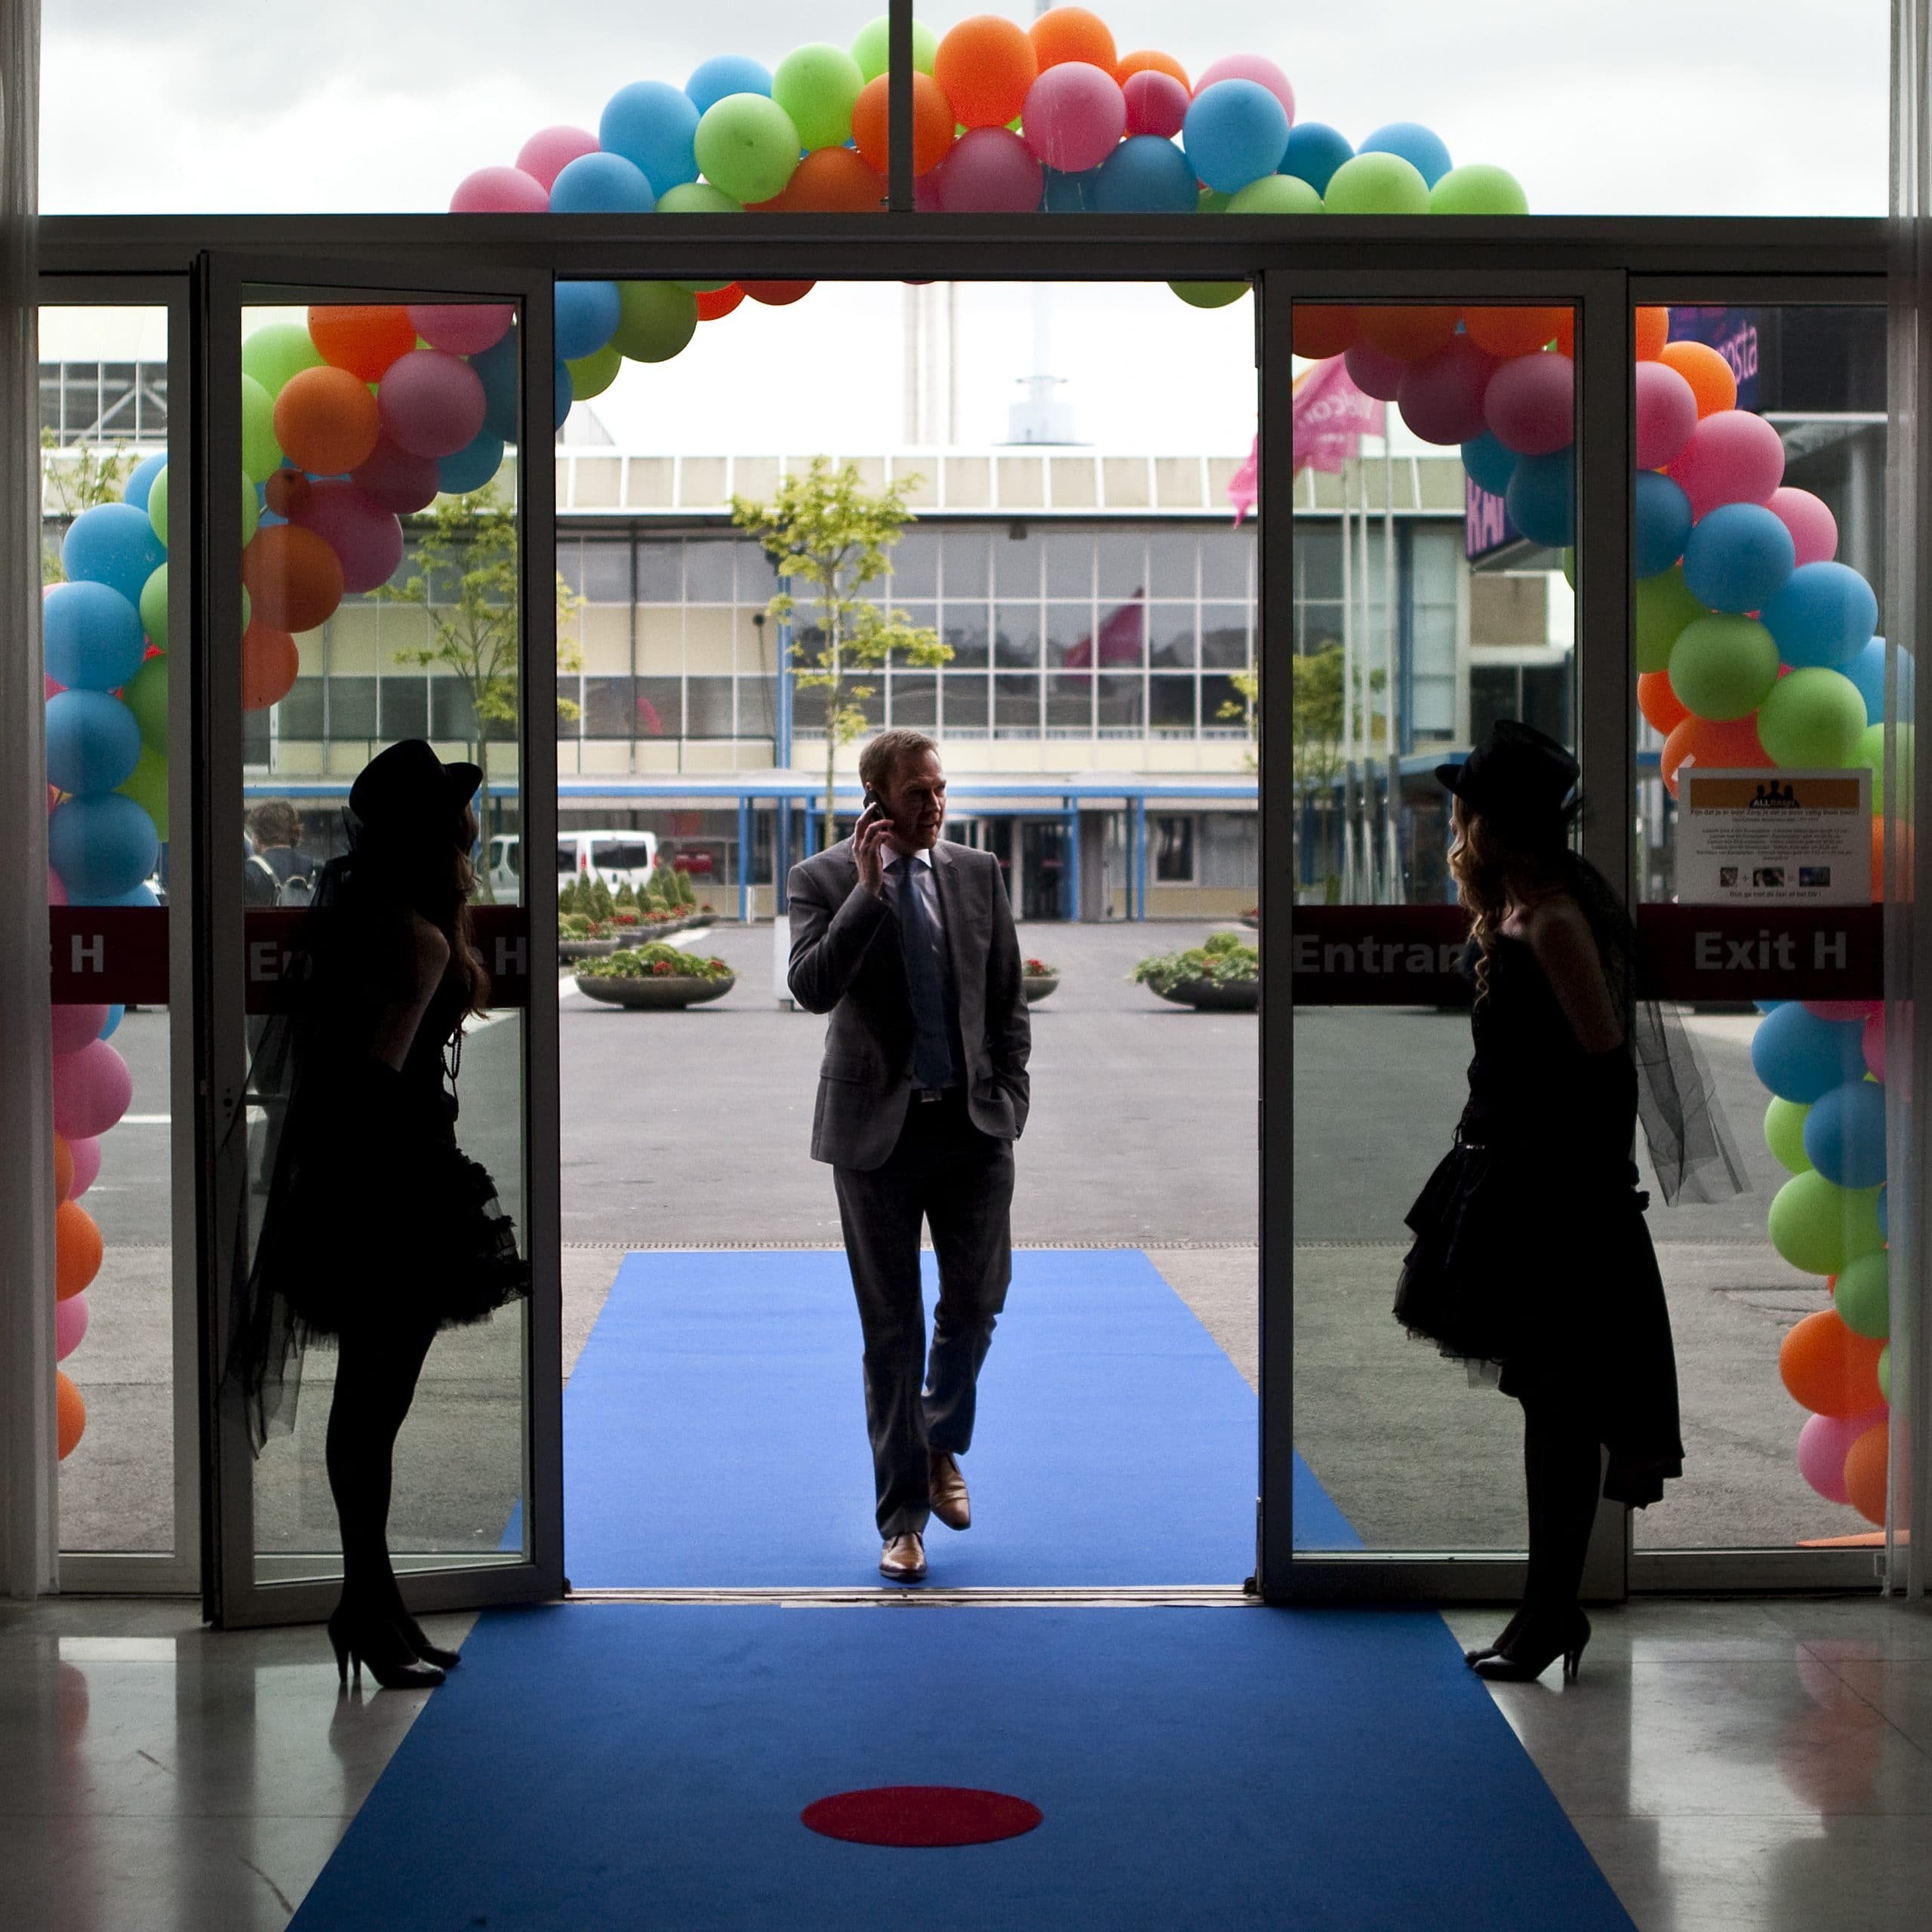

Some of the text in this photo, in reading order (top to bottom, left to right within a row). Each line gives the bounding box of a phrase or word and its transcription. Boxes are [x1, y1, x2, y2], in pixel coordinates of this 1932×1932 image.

[71, 934, 104, 973] H
[495, 936, 527, 976] H
[1292, 934, 1466, 974] Entran
[1695, 929, 1847, 970] Exit H
